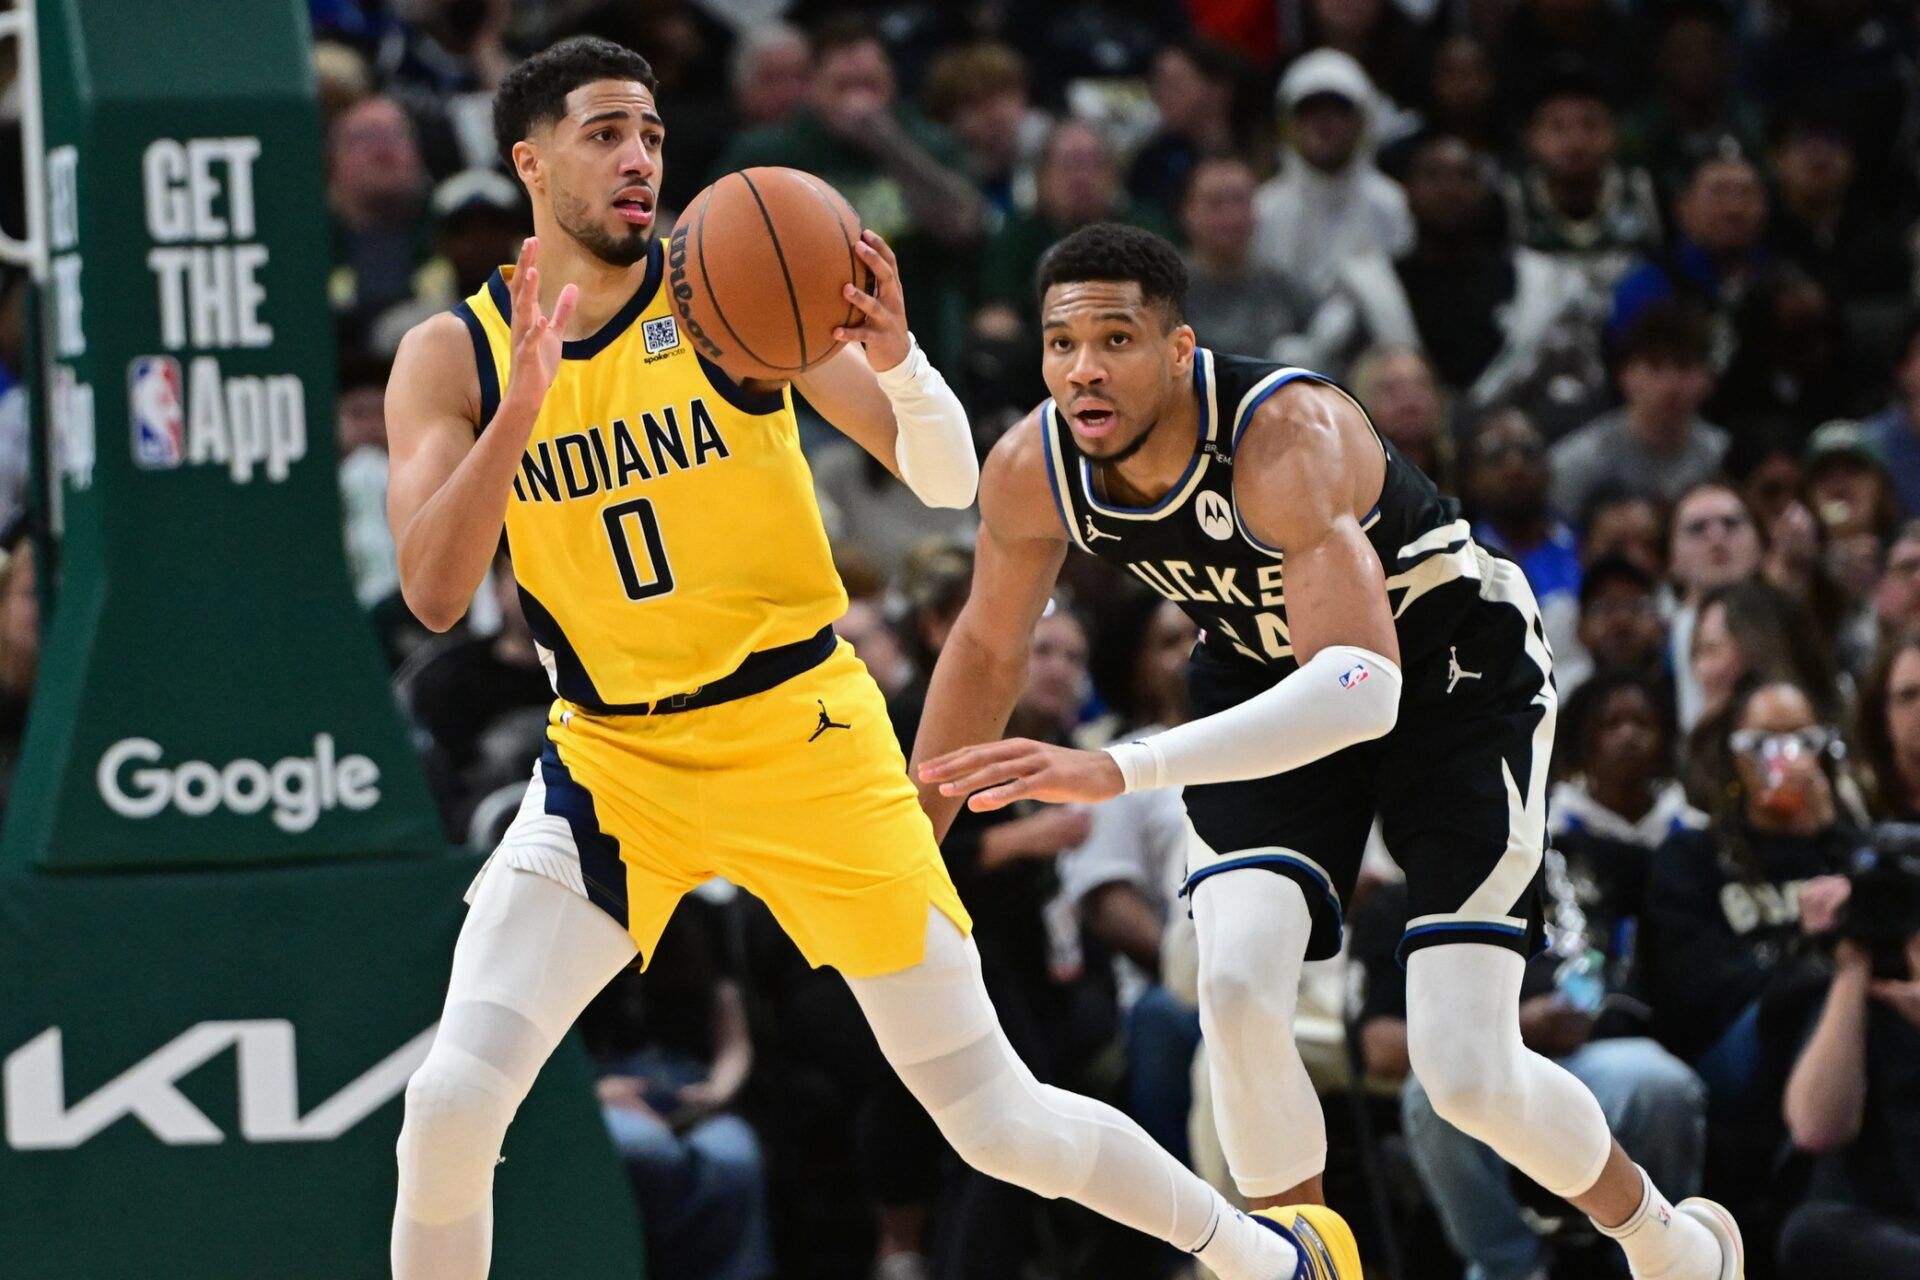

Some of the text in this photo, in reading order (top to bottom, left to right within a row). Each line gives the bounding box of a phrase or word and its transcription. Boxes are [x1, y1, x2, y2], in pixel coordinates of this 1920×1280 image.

[143, 136, 261, 242] GET
[147, 243, 274, 350] THE
[644, 348, 686, 364] spokenote
[188, 355, 307, 483] App
[602, 497, 675, 601] 0
[1127, 560, 1285, 607] UCKS
[97, 732, 381, 833] Google
